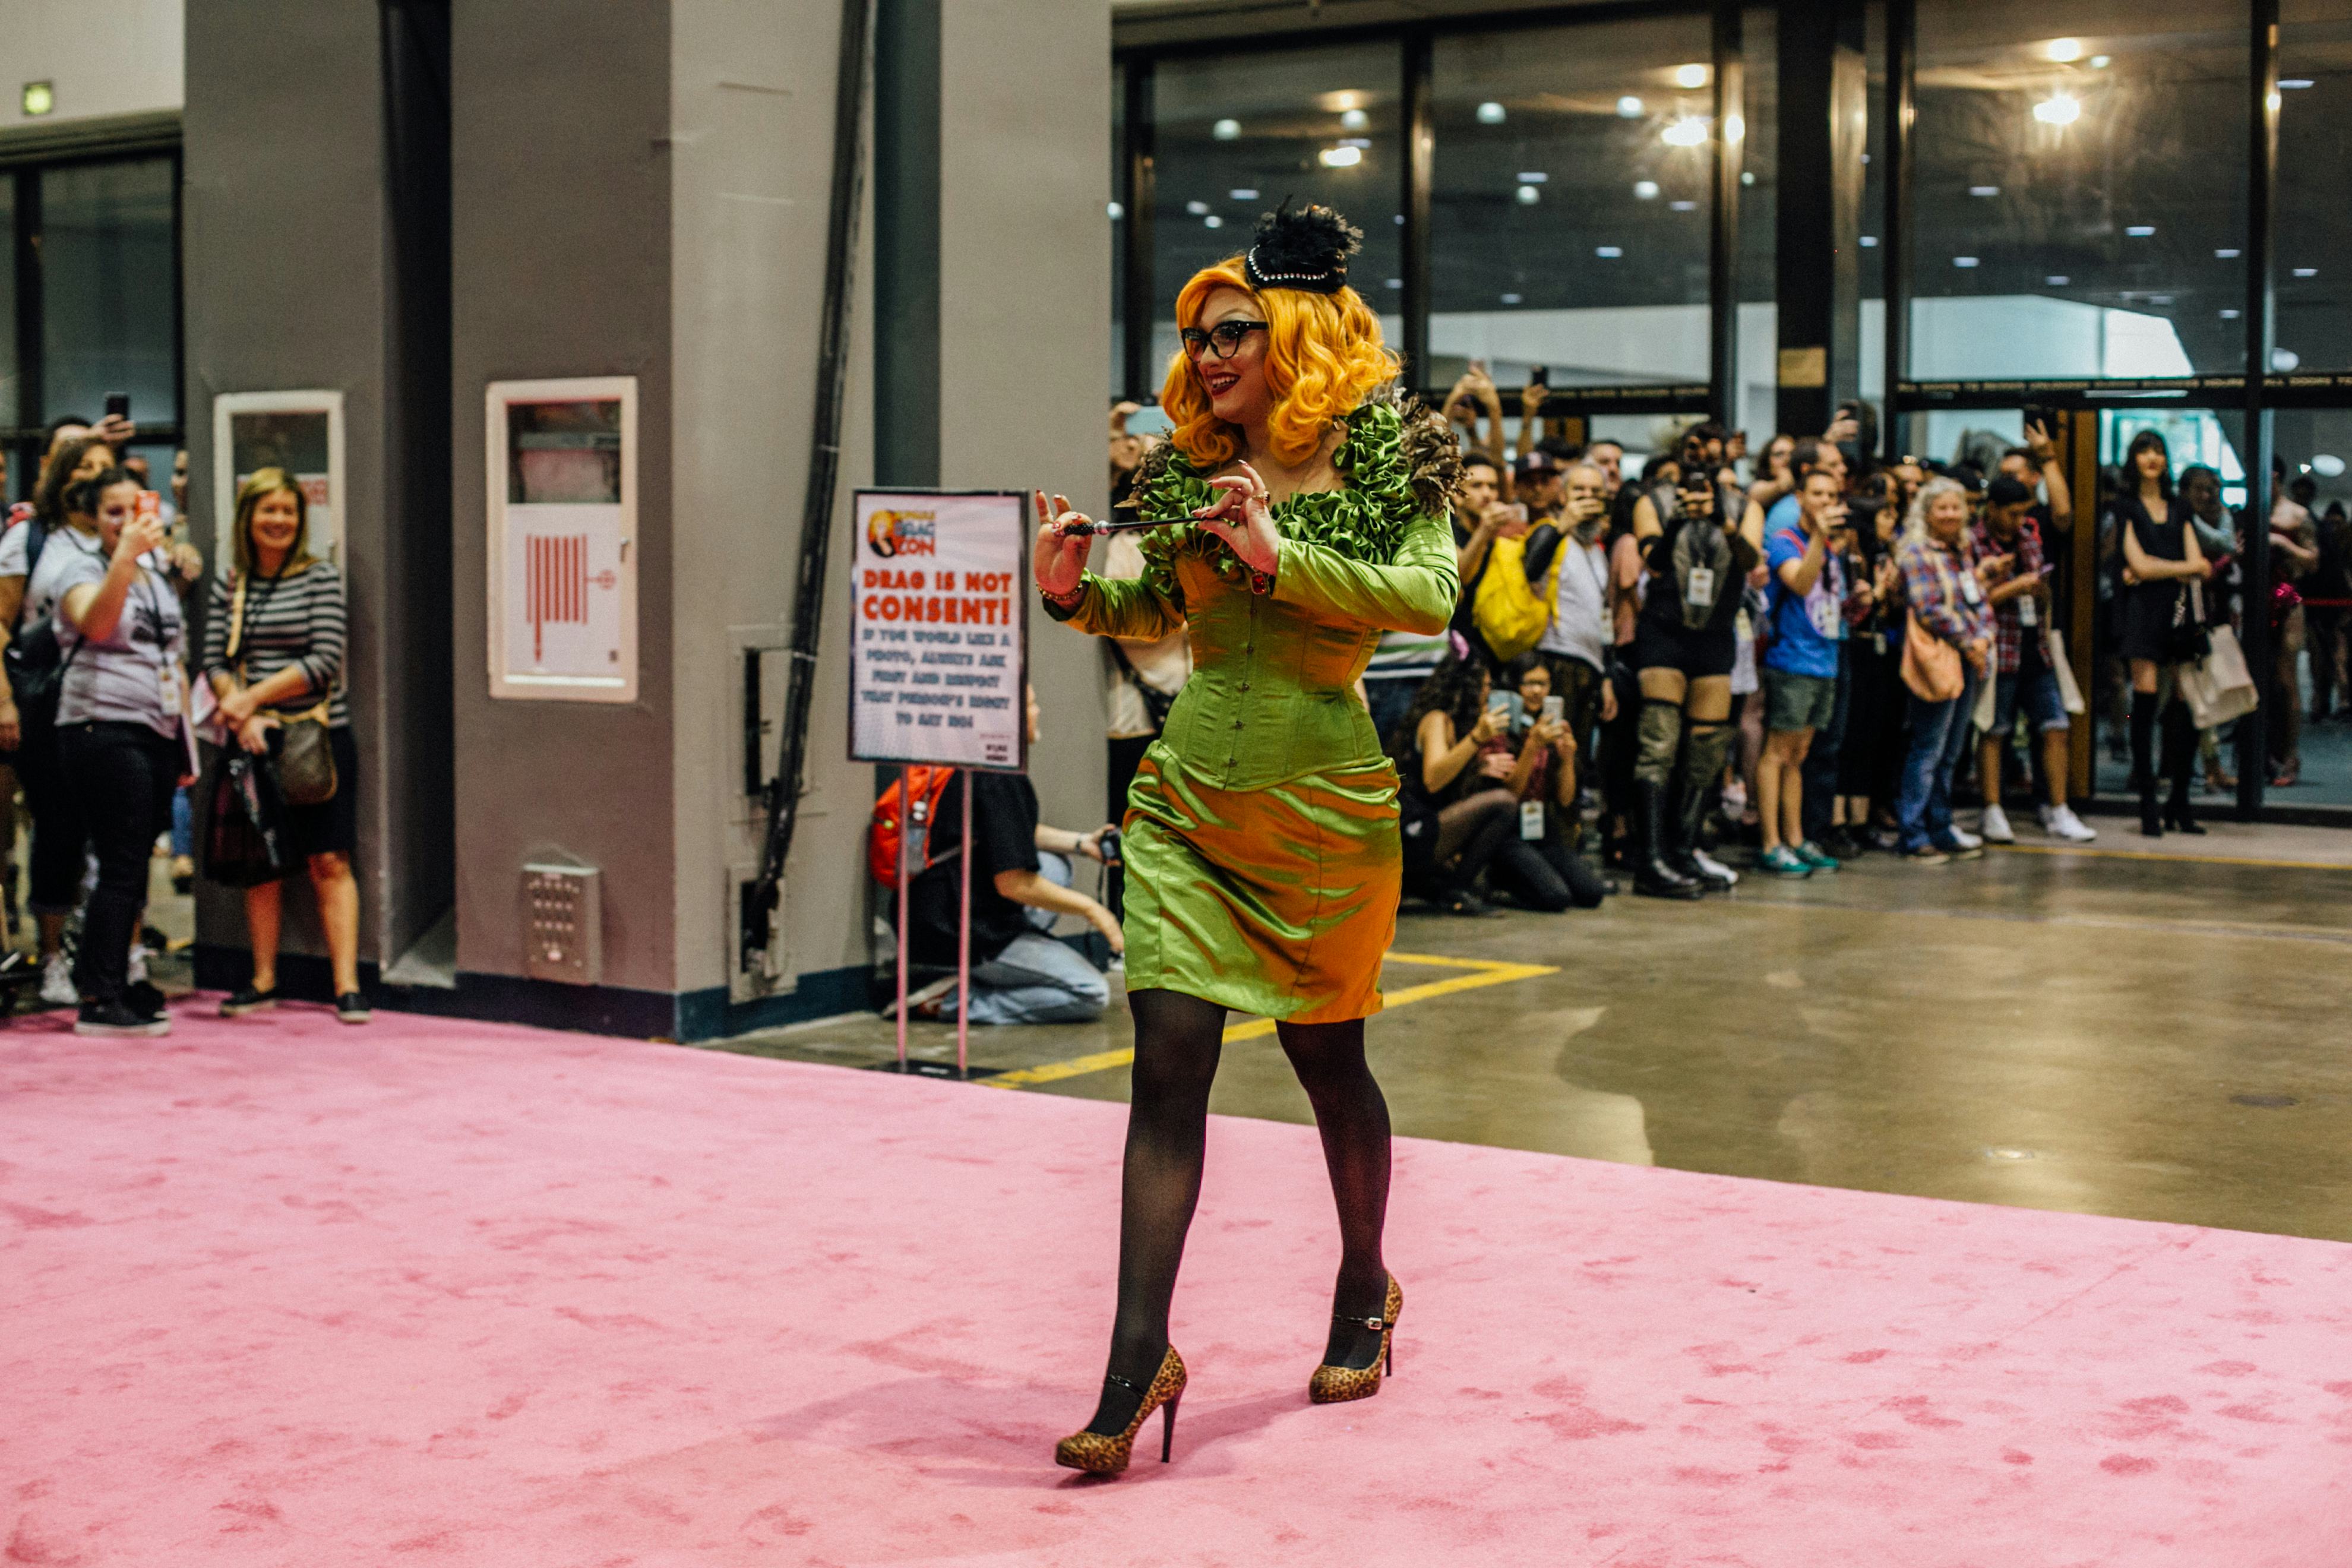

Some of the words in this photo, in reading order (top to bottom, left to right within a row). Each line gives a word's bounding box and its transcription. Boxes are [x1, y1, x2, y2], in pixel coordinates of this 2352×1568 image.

[864, 570, 925, 589] DRAG
[935, 571, 955, 591] IS
[965, 572, 1012, 593] NOT
[863, 595, 1010, 625] CONSENT!
[1001, 634, 1011, 646] A
